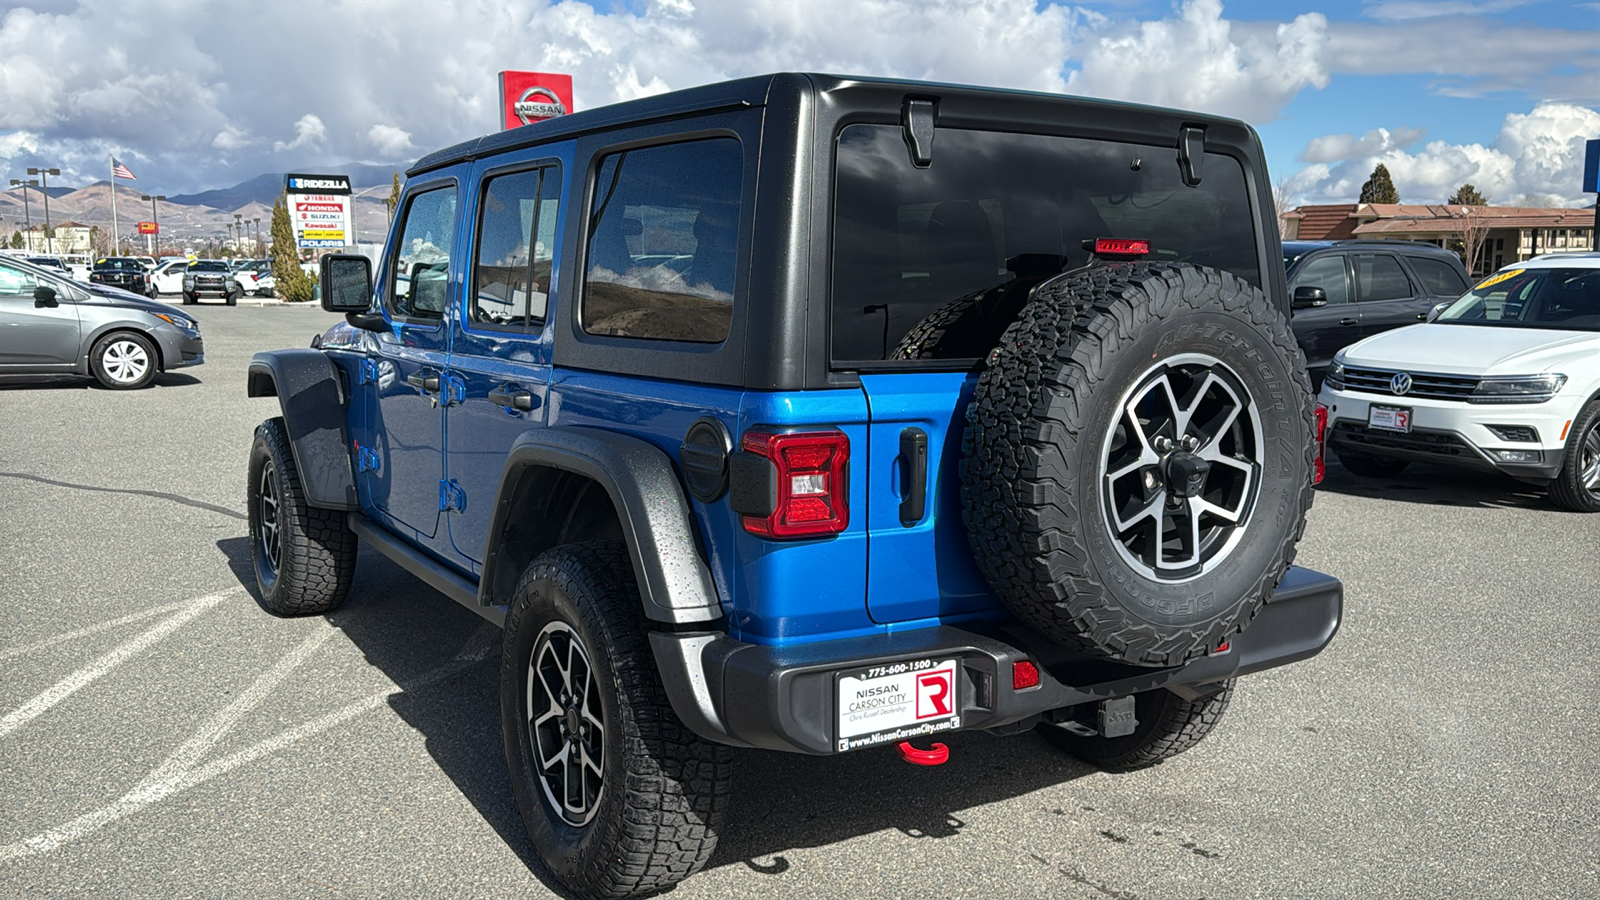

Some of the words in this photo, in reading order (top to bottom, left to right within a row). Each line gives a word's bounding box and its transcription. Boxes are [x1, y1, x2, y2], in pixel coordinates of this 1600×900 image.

[520, 104, 562, 115] NISSAN
[304, 179, 349, 189] RIDEZILLA
[868, 659, 931, 678] 775-600-1500
[856, 684, 899, 699] NISSAN
[849, 697, 885, 712] CARSON
[888, 693, 907, 705] CITY
[849, 713, 862, 722] Chris
[863, 710, 879, 719] Russell
[880, 706, 906, 717] Dealership
[1109, 710, 1133, 723] Jeep
[849, 722, 951, 748] www.NissanCarsonCity.com
